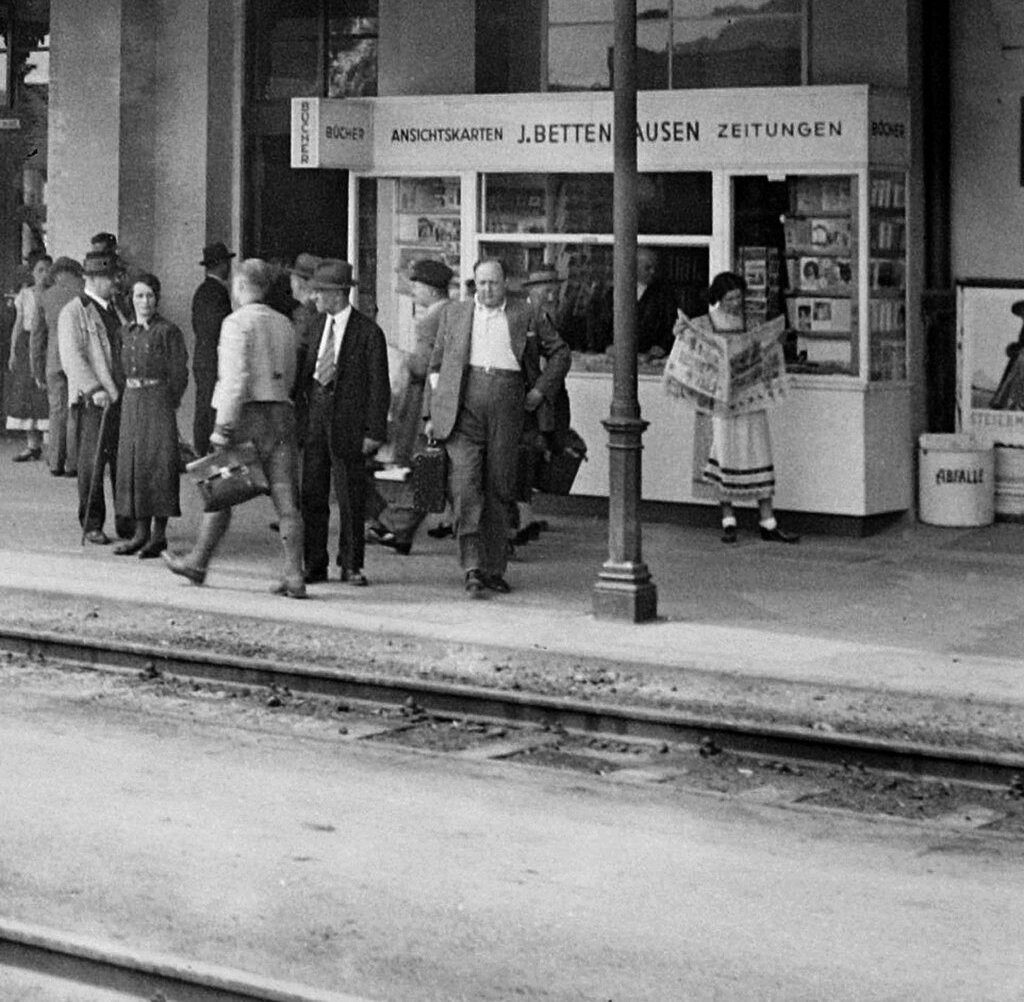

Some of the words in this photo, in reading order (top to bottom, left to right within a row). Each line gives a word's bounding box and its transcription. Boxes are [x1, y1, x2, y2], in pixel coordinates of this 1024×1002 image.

[391, 127, 503, 142] ANSICHTSKARTEN
[517, 120, 700, 144] J.BETTENAUSEN
[717, 120, 843, 138] ZEITUNGEN
